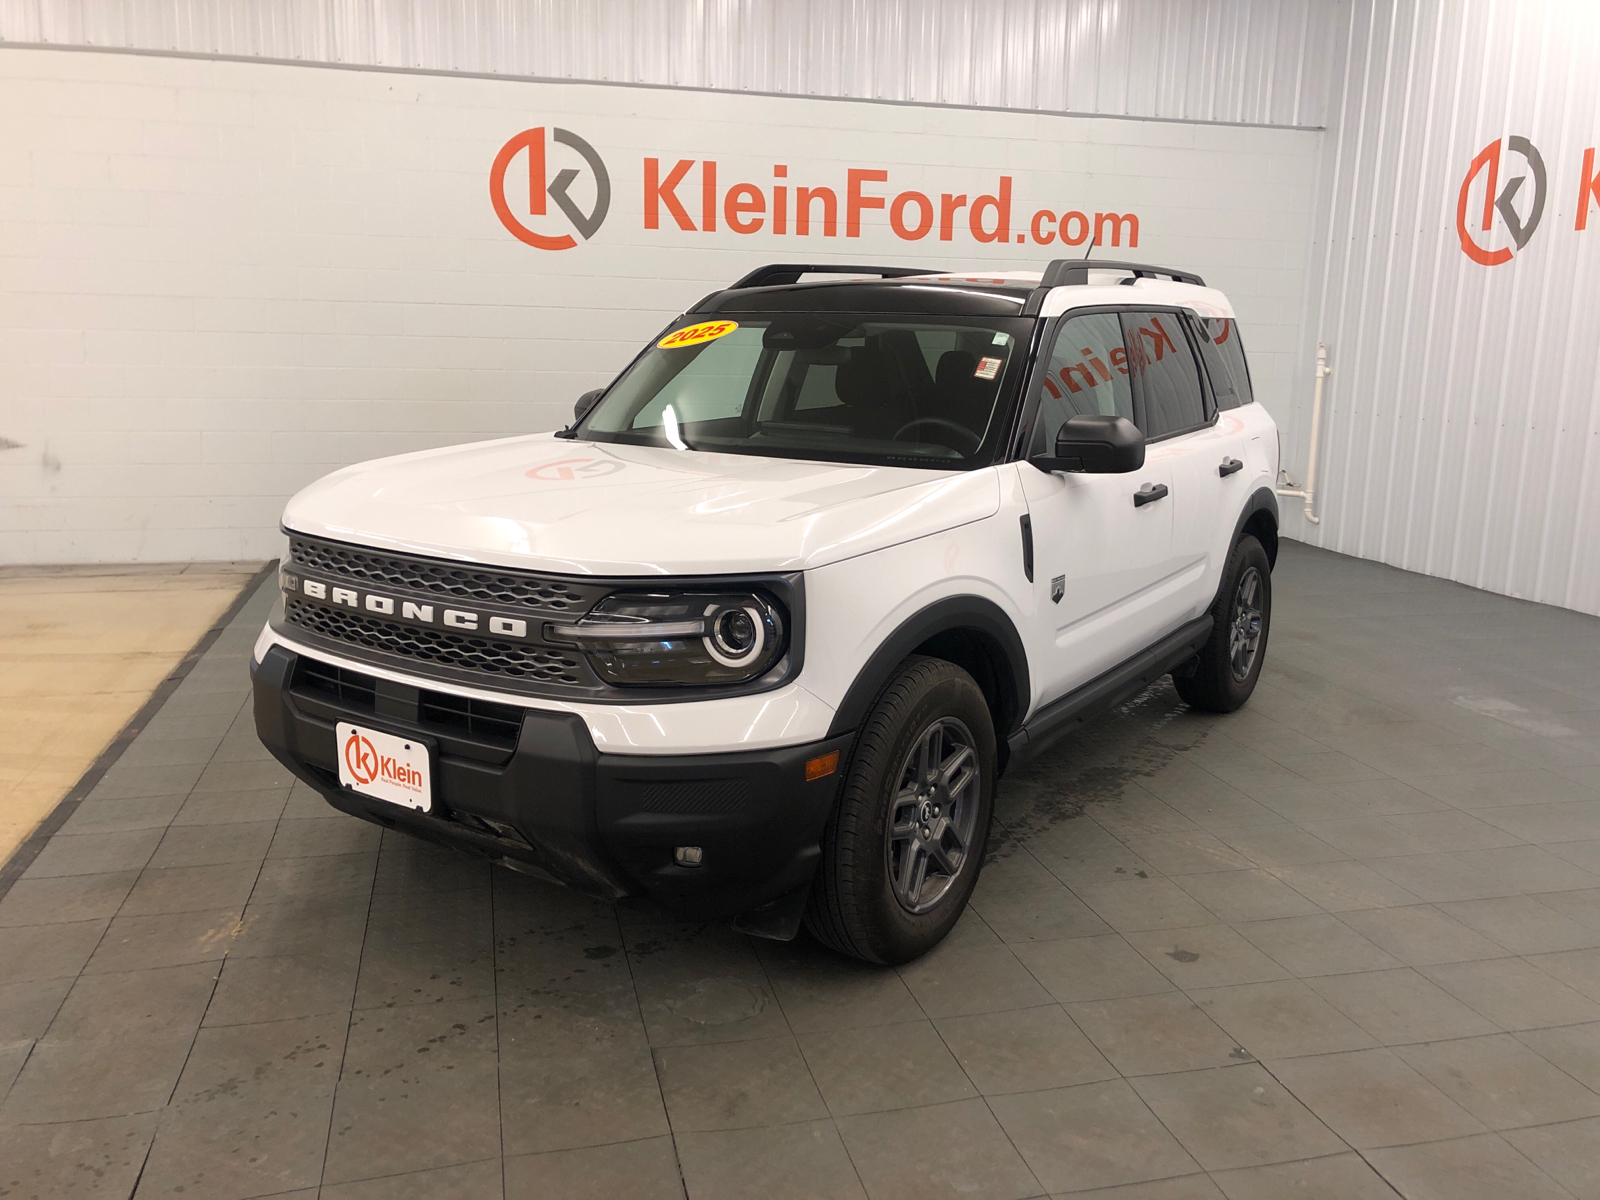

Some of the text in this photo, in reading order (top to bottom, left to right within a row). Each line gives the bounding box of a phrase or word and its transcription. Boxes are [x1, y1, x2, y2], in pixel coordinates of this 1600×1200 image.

[643, 157, 1139, 248] KleinFord.com
[663, 324, 731, 345] 2025
[303, 579, 527, 638] BRONCO
[381, 756, 422, 787] Klein
